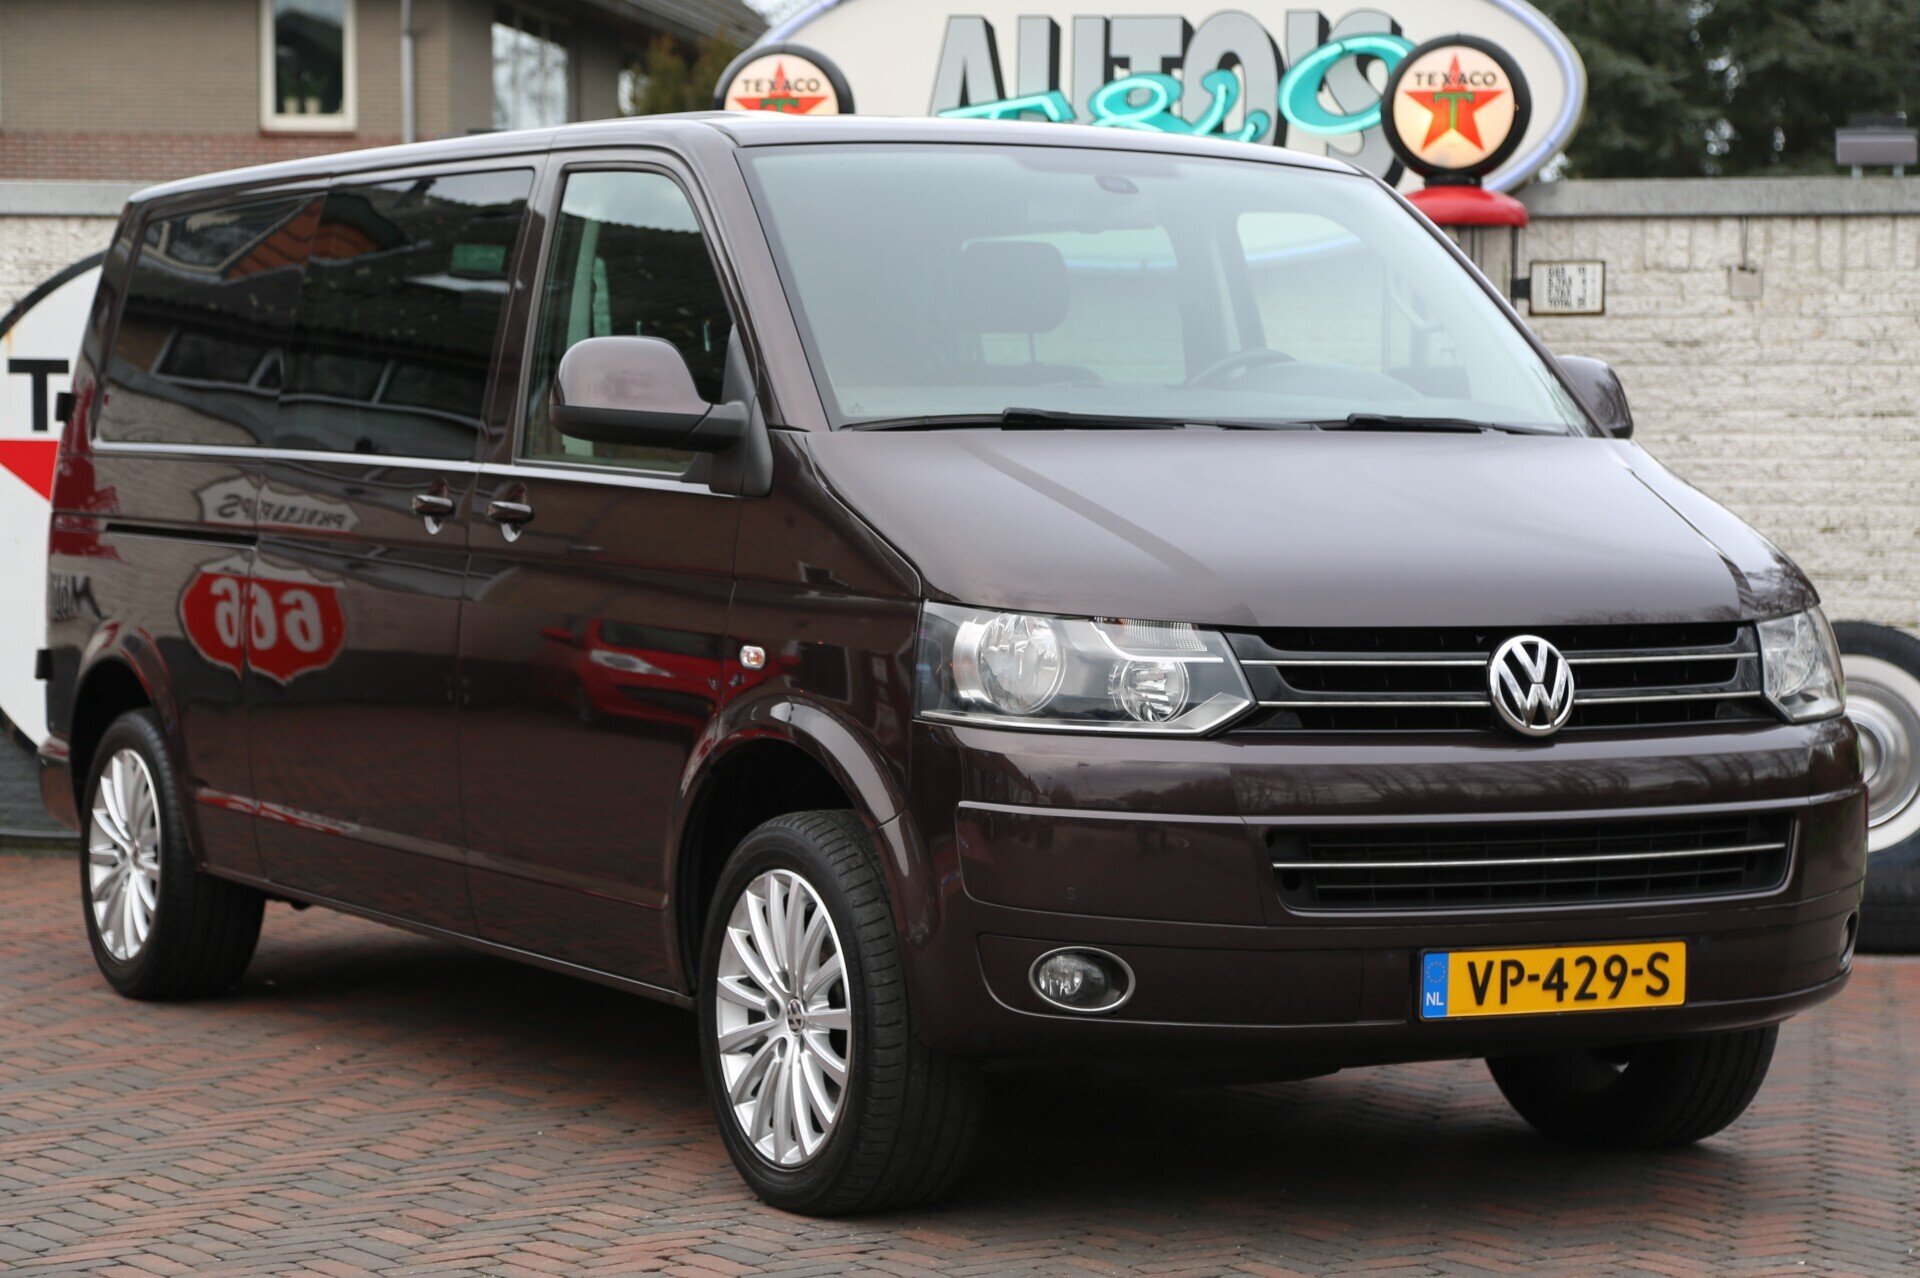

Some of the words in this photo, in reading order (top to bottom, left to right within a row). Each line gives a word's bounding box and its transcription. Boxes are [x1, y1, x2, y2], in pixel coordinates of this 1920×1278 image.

[742, 78, 821, 92] TEXACO
[1414, 71, 1497, 86] TEXACO
[1433, 92, 1475, 129] T
[1467, 951, 1670, 1006] VP-429-S
[1426, 992, 1444, 1006] NL
